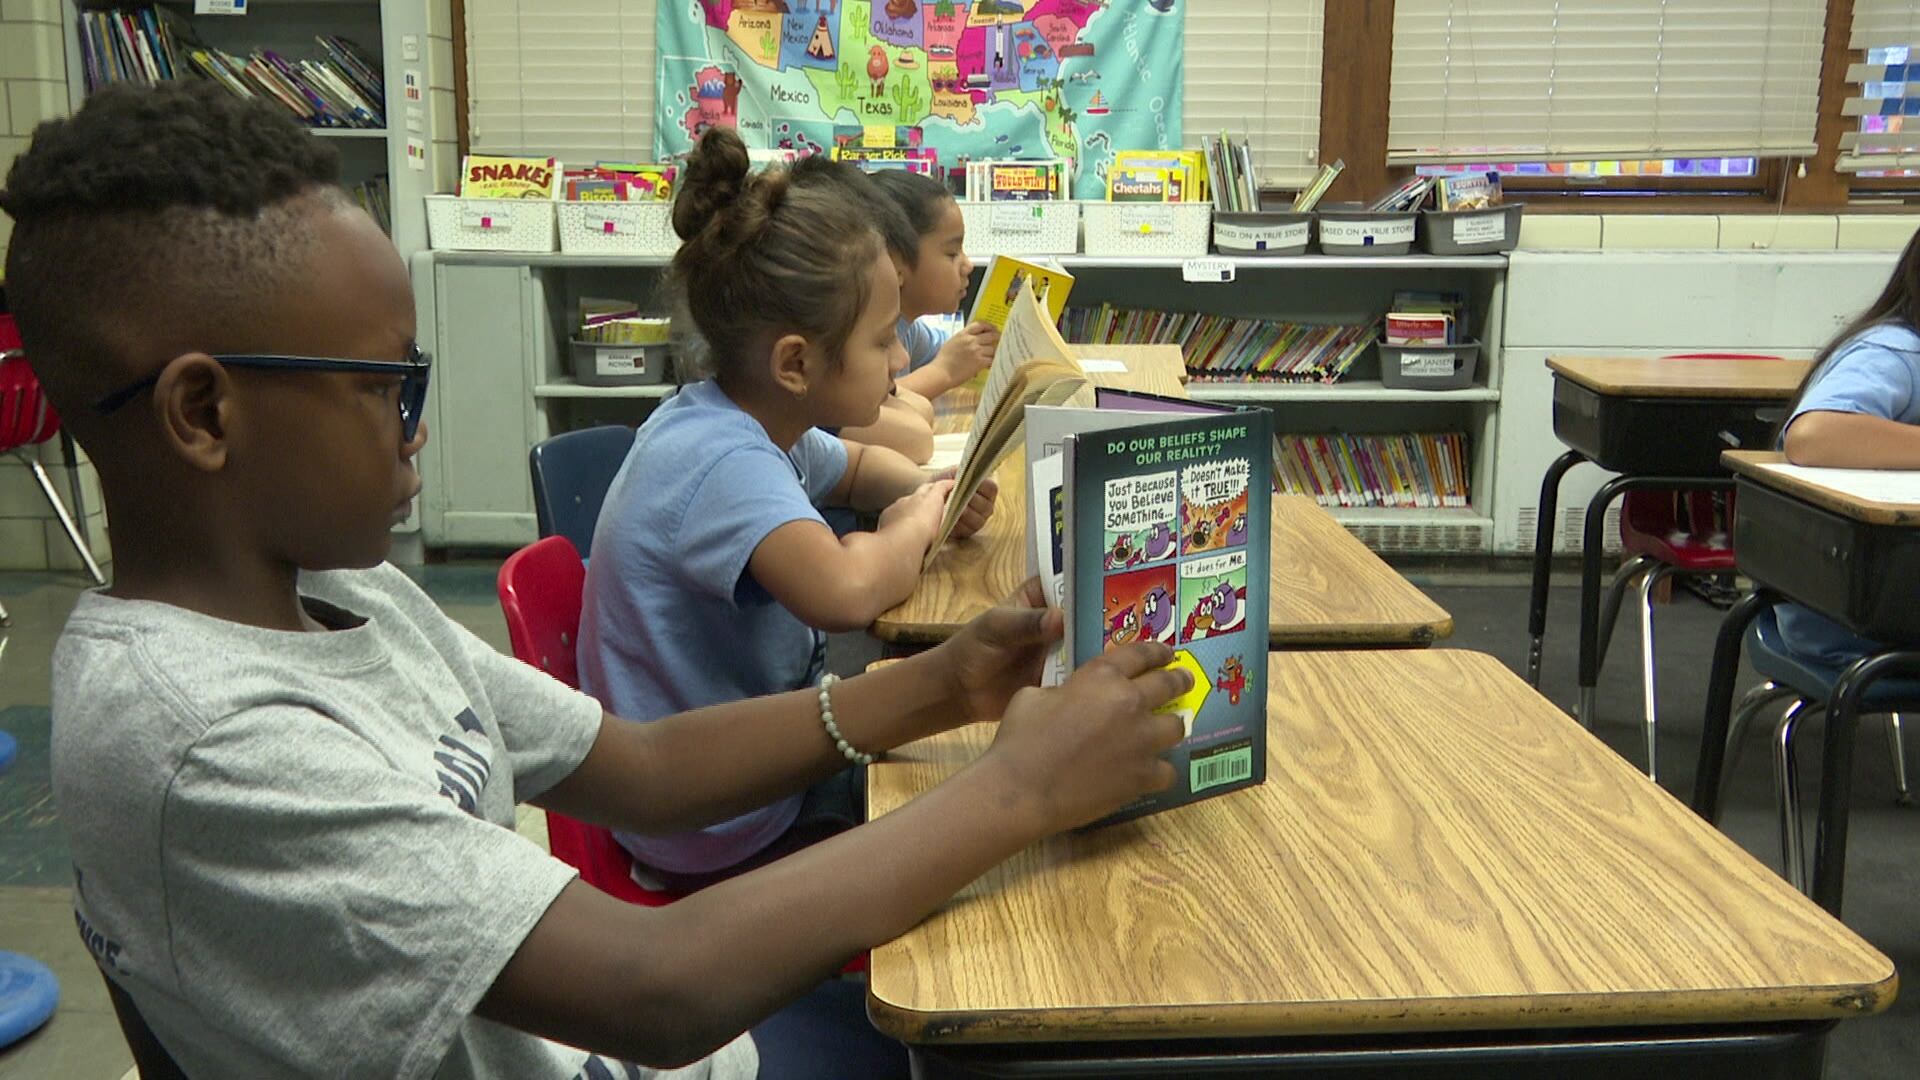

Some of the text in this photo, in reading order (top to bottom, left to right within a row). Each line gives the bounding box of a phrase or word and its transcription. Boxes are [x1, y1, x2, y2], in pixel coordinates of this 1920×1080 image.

[739, 15, 772, 30] Arizona
[787, 17, 804, 31] New
[873, 20, 914, 39] Oklahoma
[783, 31, 809, 44] Mexico
[770, 84, 810, 104] Mexico
[857, 96, 893, 115] Texas
[932, 97, 969, 109] Louisiana
[883, 149, 908, 161] Rick
[469, 163, 553, 189] SNAKES
[995, 174, 1023, 188] WOULD
[1113, 182, 1162, 195] Cheetahs
[579, 191, 617, 201] Bison
[1239, 232, 1253, 240] ON
[1263, 230, 1283, 239] TRUE
[1284, 228, 1307, 238] STORY
[1345, 227, 1360, 236] ON
[1370, 226, 1390, 235] TRUE
[1187, 261, 1229, 270] MYSTERY
[1107, 426, 1247, 455] DO OUR BELIEFS SHAPE
[1135, 443, 1221, 466] OUR REALITY?
[1185, 565, 1193, 576] It
[1197, 562, 1214, 573] does
[1215, 558, 1226, 570] for
